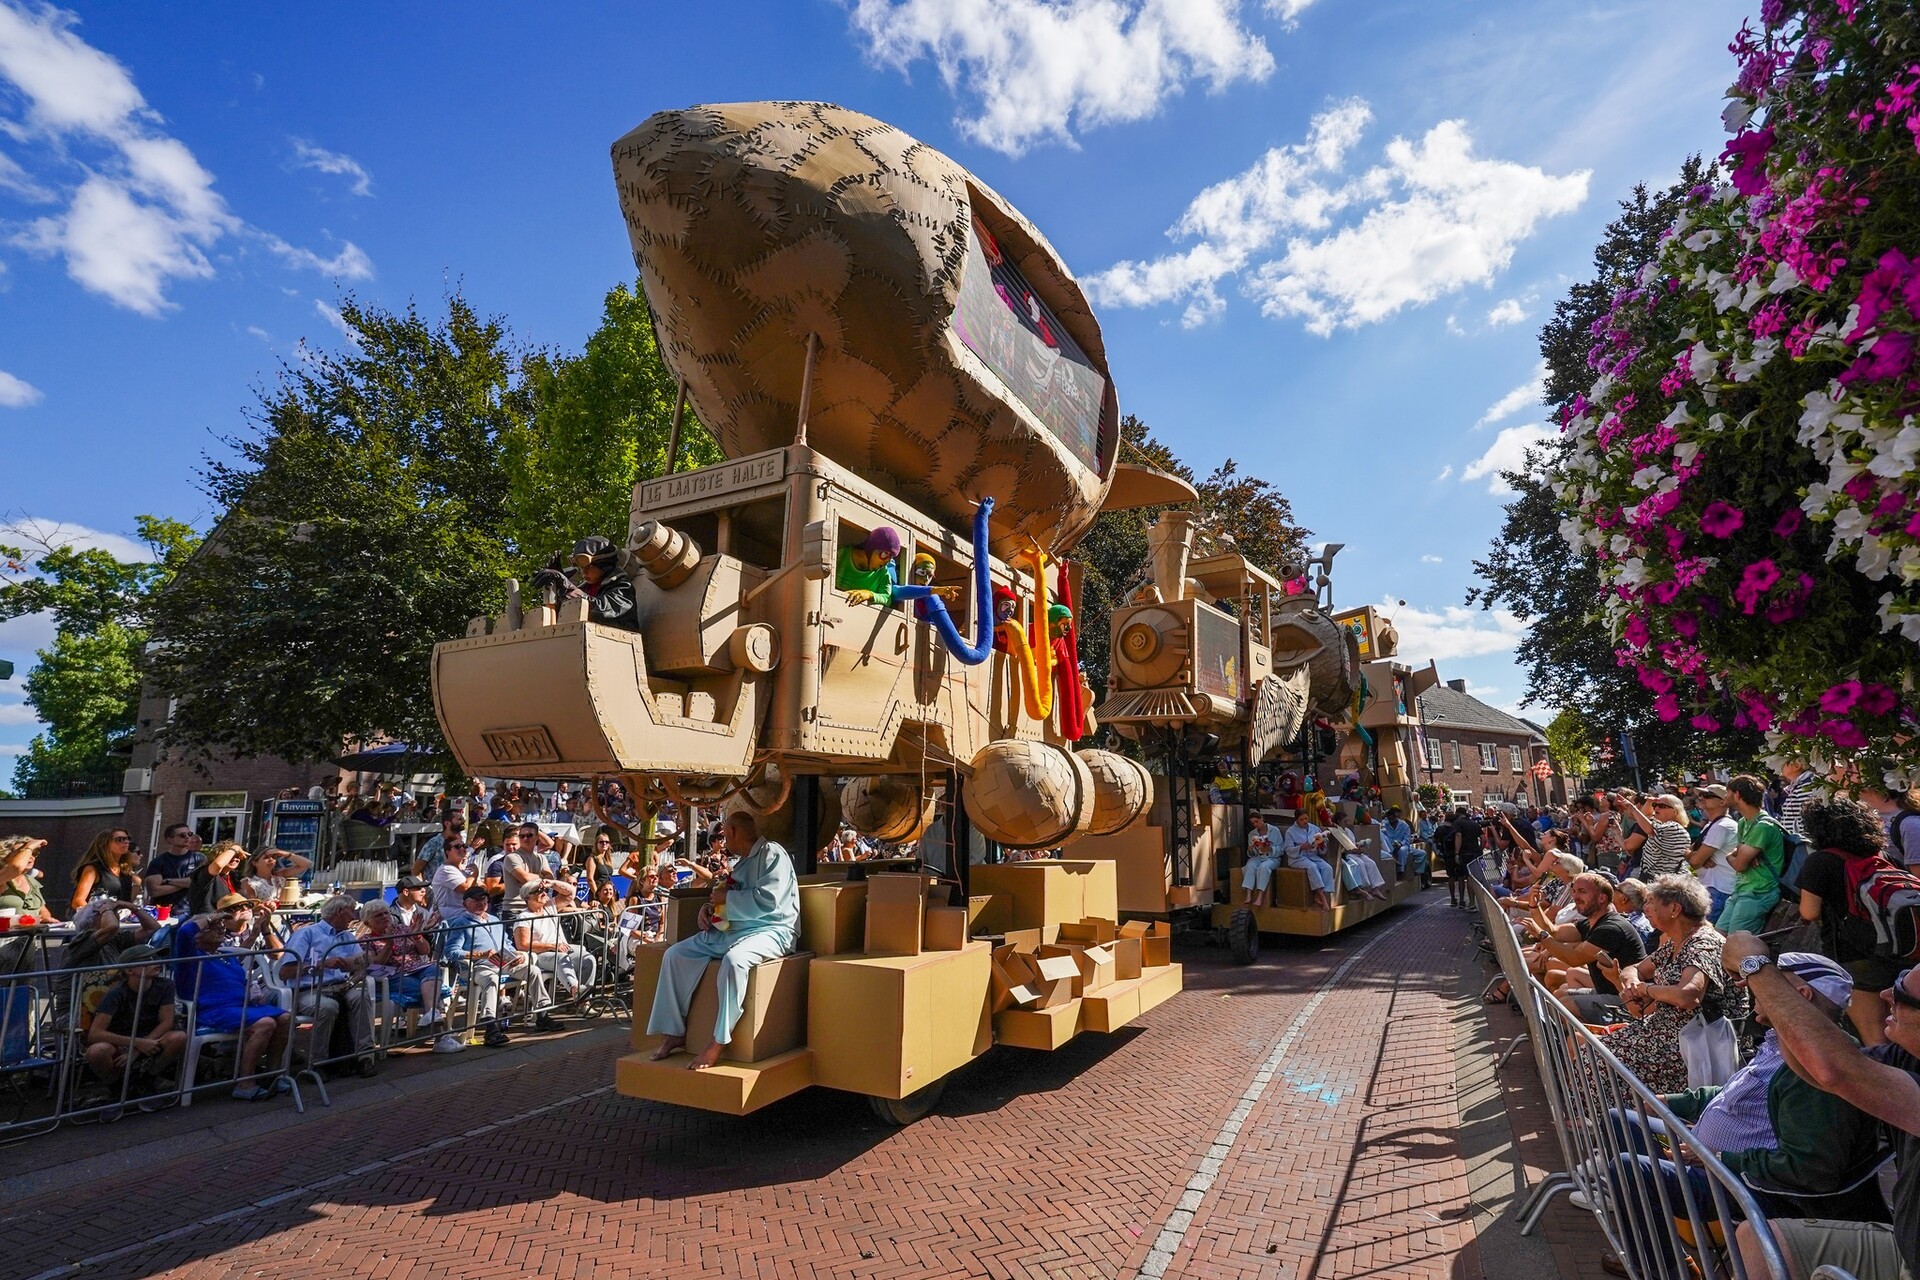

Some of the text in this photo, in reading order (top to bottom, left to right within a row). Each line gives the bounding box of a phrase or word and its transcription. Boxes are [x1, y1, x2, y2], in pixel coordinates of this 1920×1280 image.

[667, 471, 724, 499] LAATSTE
[731, 458, 775, 485] HALTE
[281, 803, 320, 811] Bavaria
